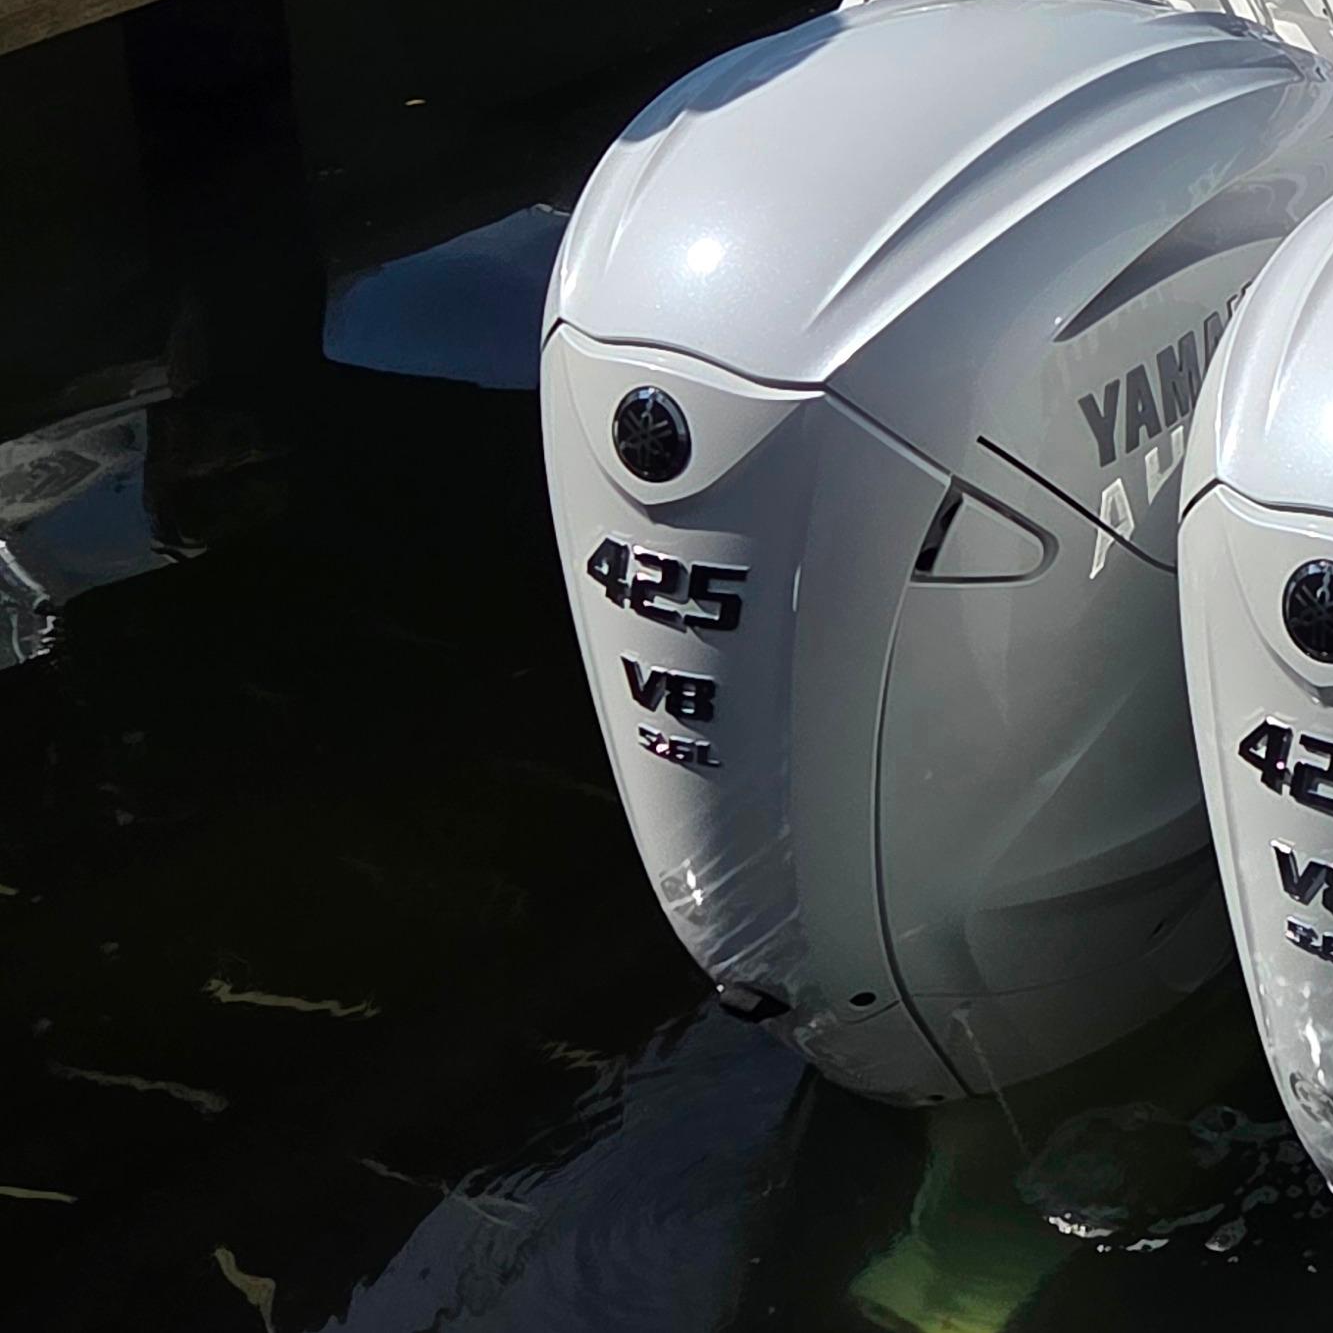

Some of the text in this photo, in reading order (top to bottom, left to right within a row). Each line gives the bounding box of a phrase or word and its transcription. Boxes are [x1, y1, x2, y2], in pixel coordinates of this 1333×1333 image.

[1077, 281, 1253, 468] YAMA
[587, 534, 750, 633] 425
[621, 654, 716, 722] V8
